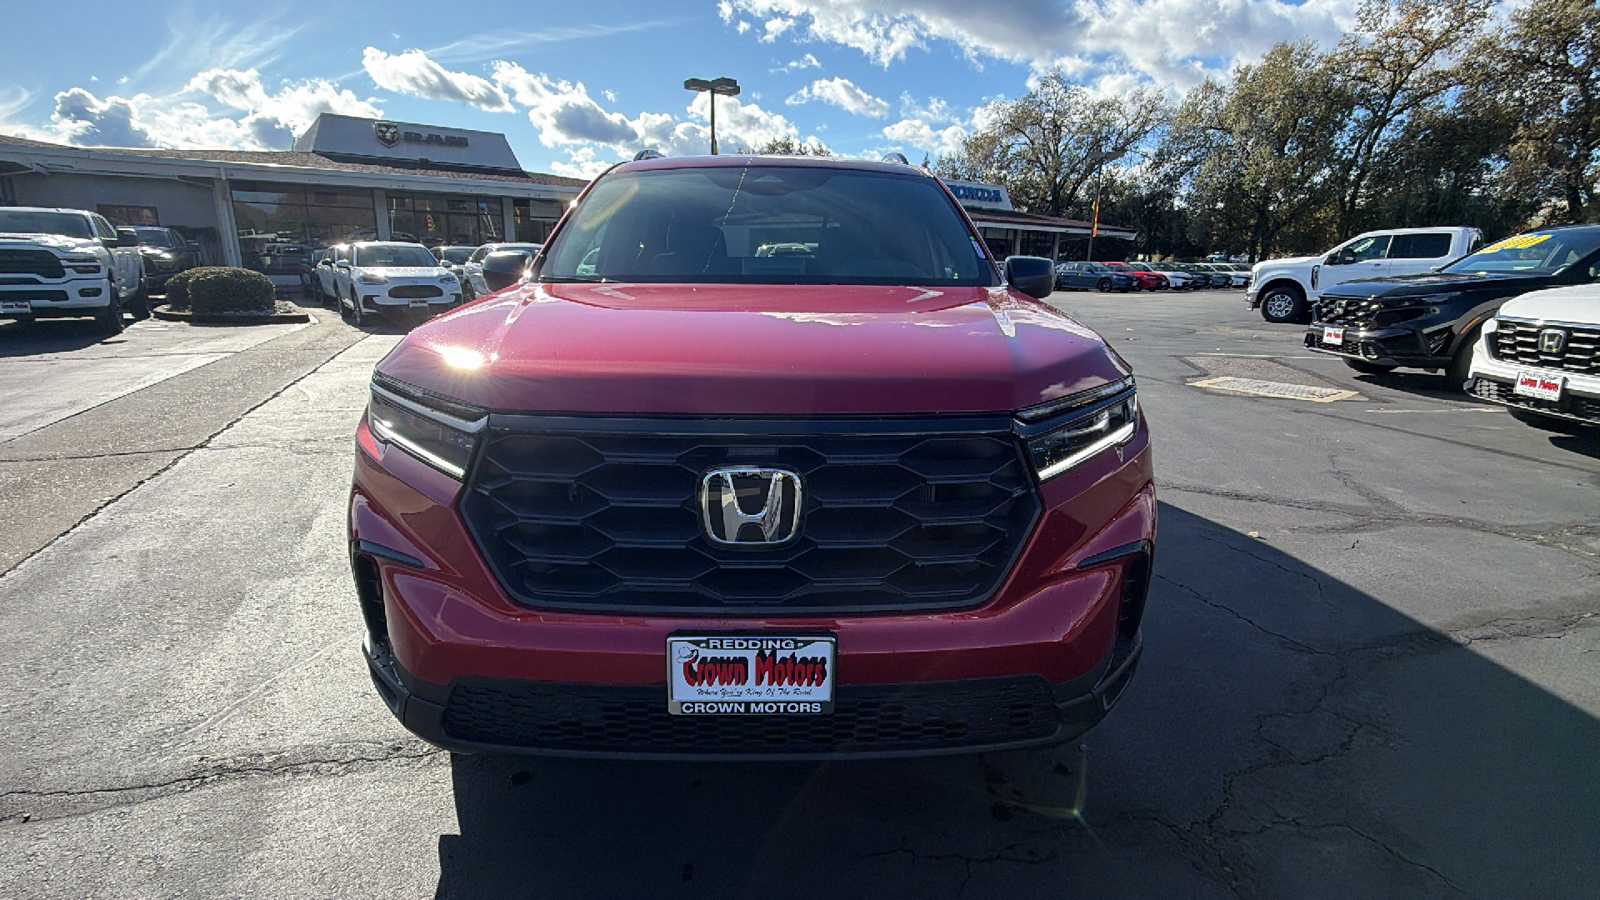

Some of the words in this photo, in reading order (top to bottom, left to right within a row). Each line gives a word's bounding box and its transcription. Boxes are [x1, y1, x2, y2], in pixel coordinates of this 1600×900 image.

[709, 639, 795, 649] REDDING
[682, 649, 749, 687] Crown
[755, 650, 827, 687] Motors
[681, 702, 745, 714] CROWN
[750, 702, 822, 714] MOTORS
